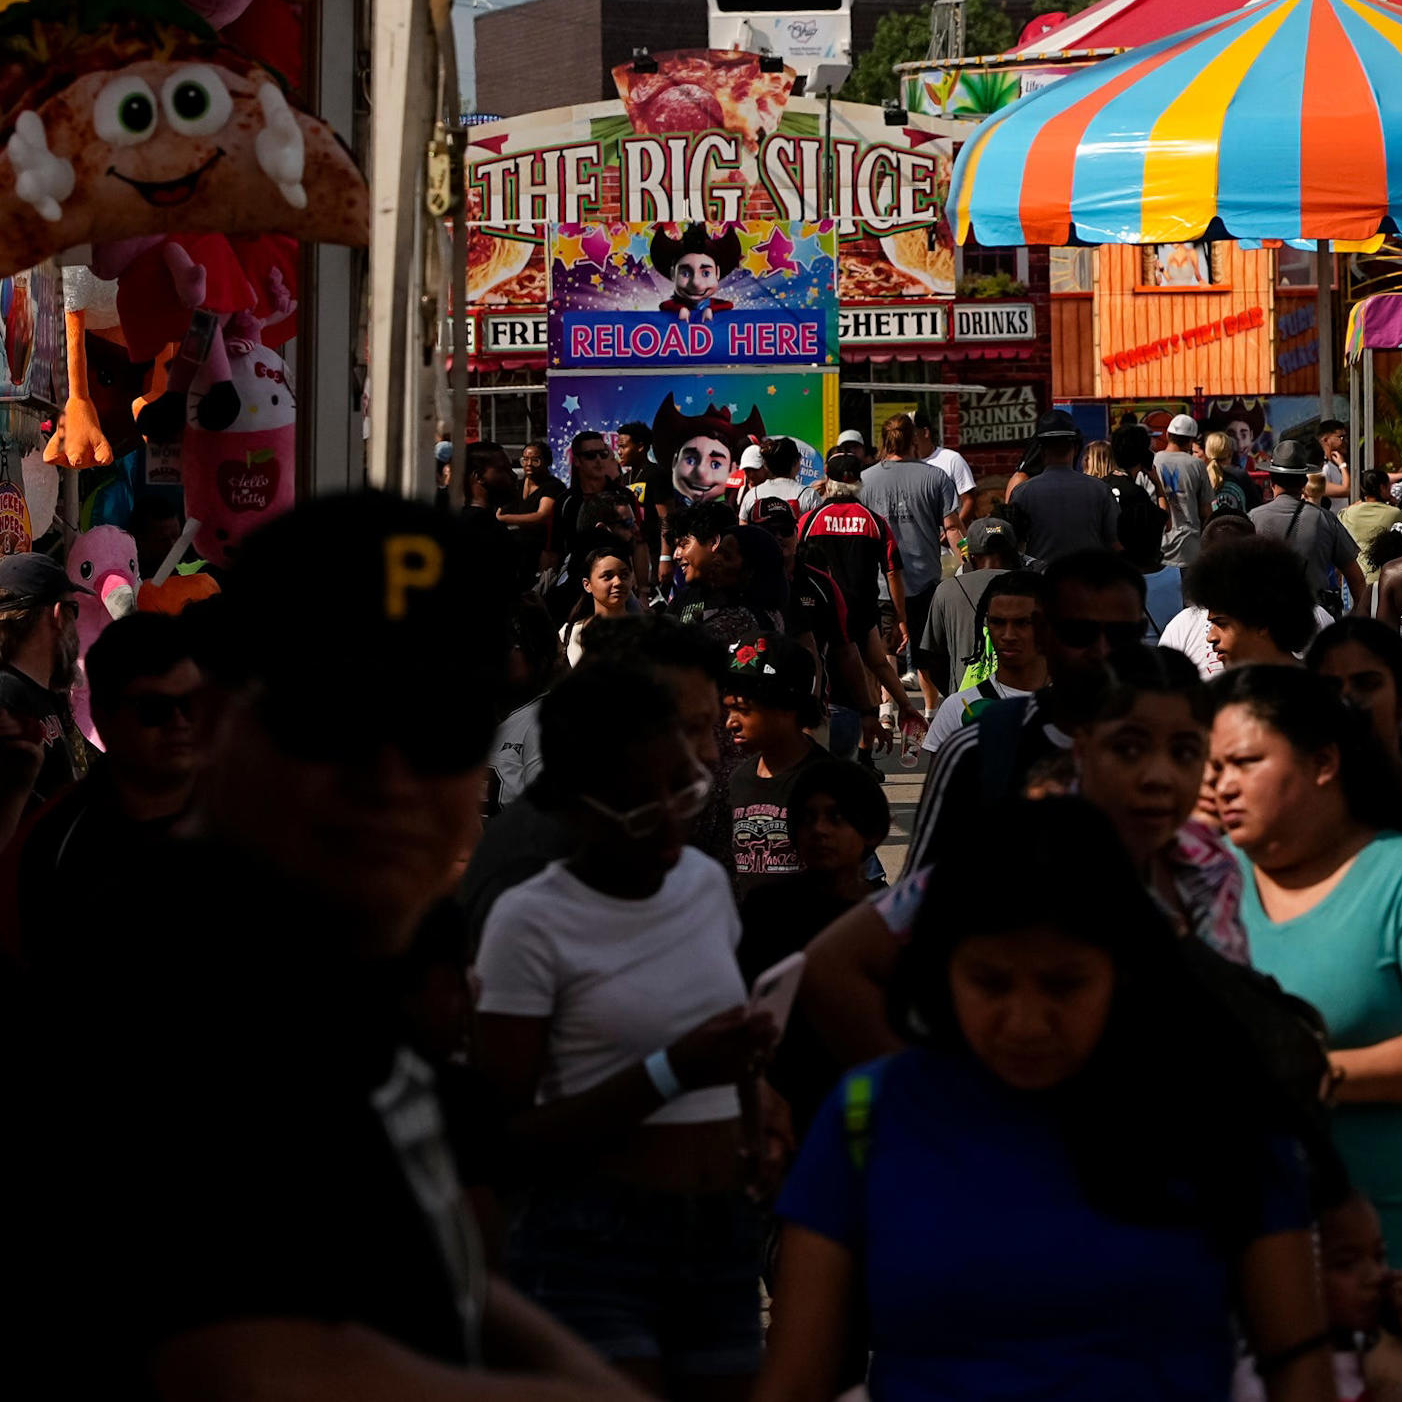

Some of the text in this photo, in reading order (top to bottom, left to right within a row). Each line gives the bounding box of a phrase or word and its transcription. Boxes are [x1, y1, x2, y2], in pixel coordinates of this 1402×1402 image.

[476, 133, 936, 237] THE BIG SLICE
[491, 320, 547, 346] FRE
[839, 310, 938, 338] GHETTI
[958, 310, 1029, 336] DRINKS
[1182, 319, 1222, 350] TIKI
[1223, 306, 1264, 338] BAR
[571, 322, 818, 358] RELOAD HERE
[824, 515, 867, 533] TALLEY
[380, 532, 447, 622] P
